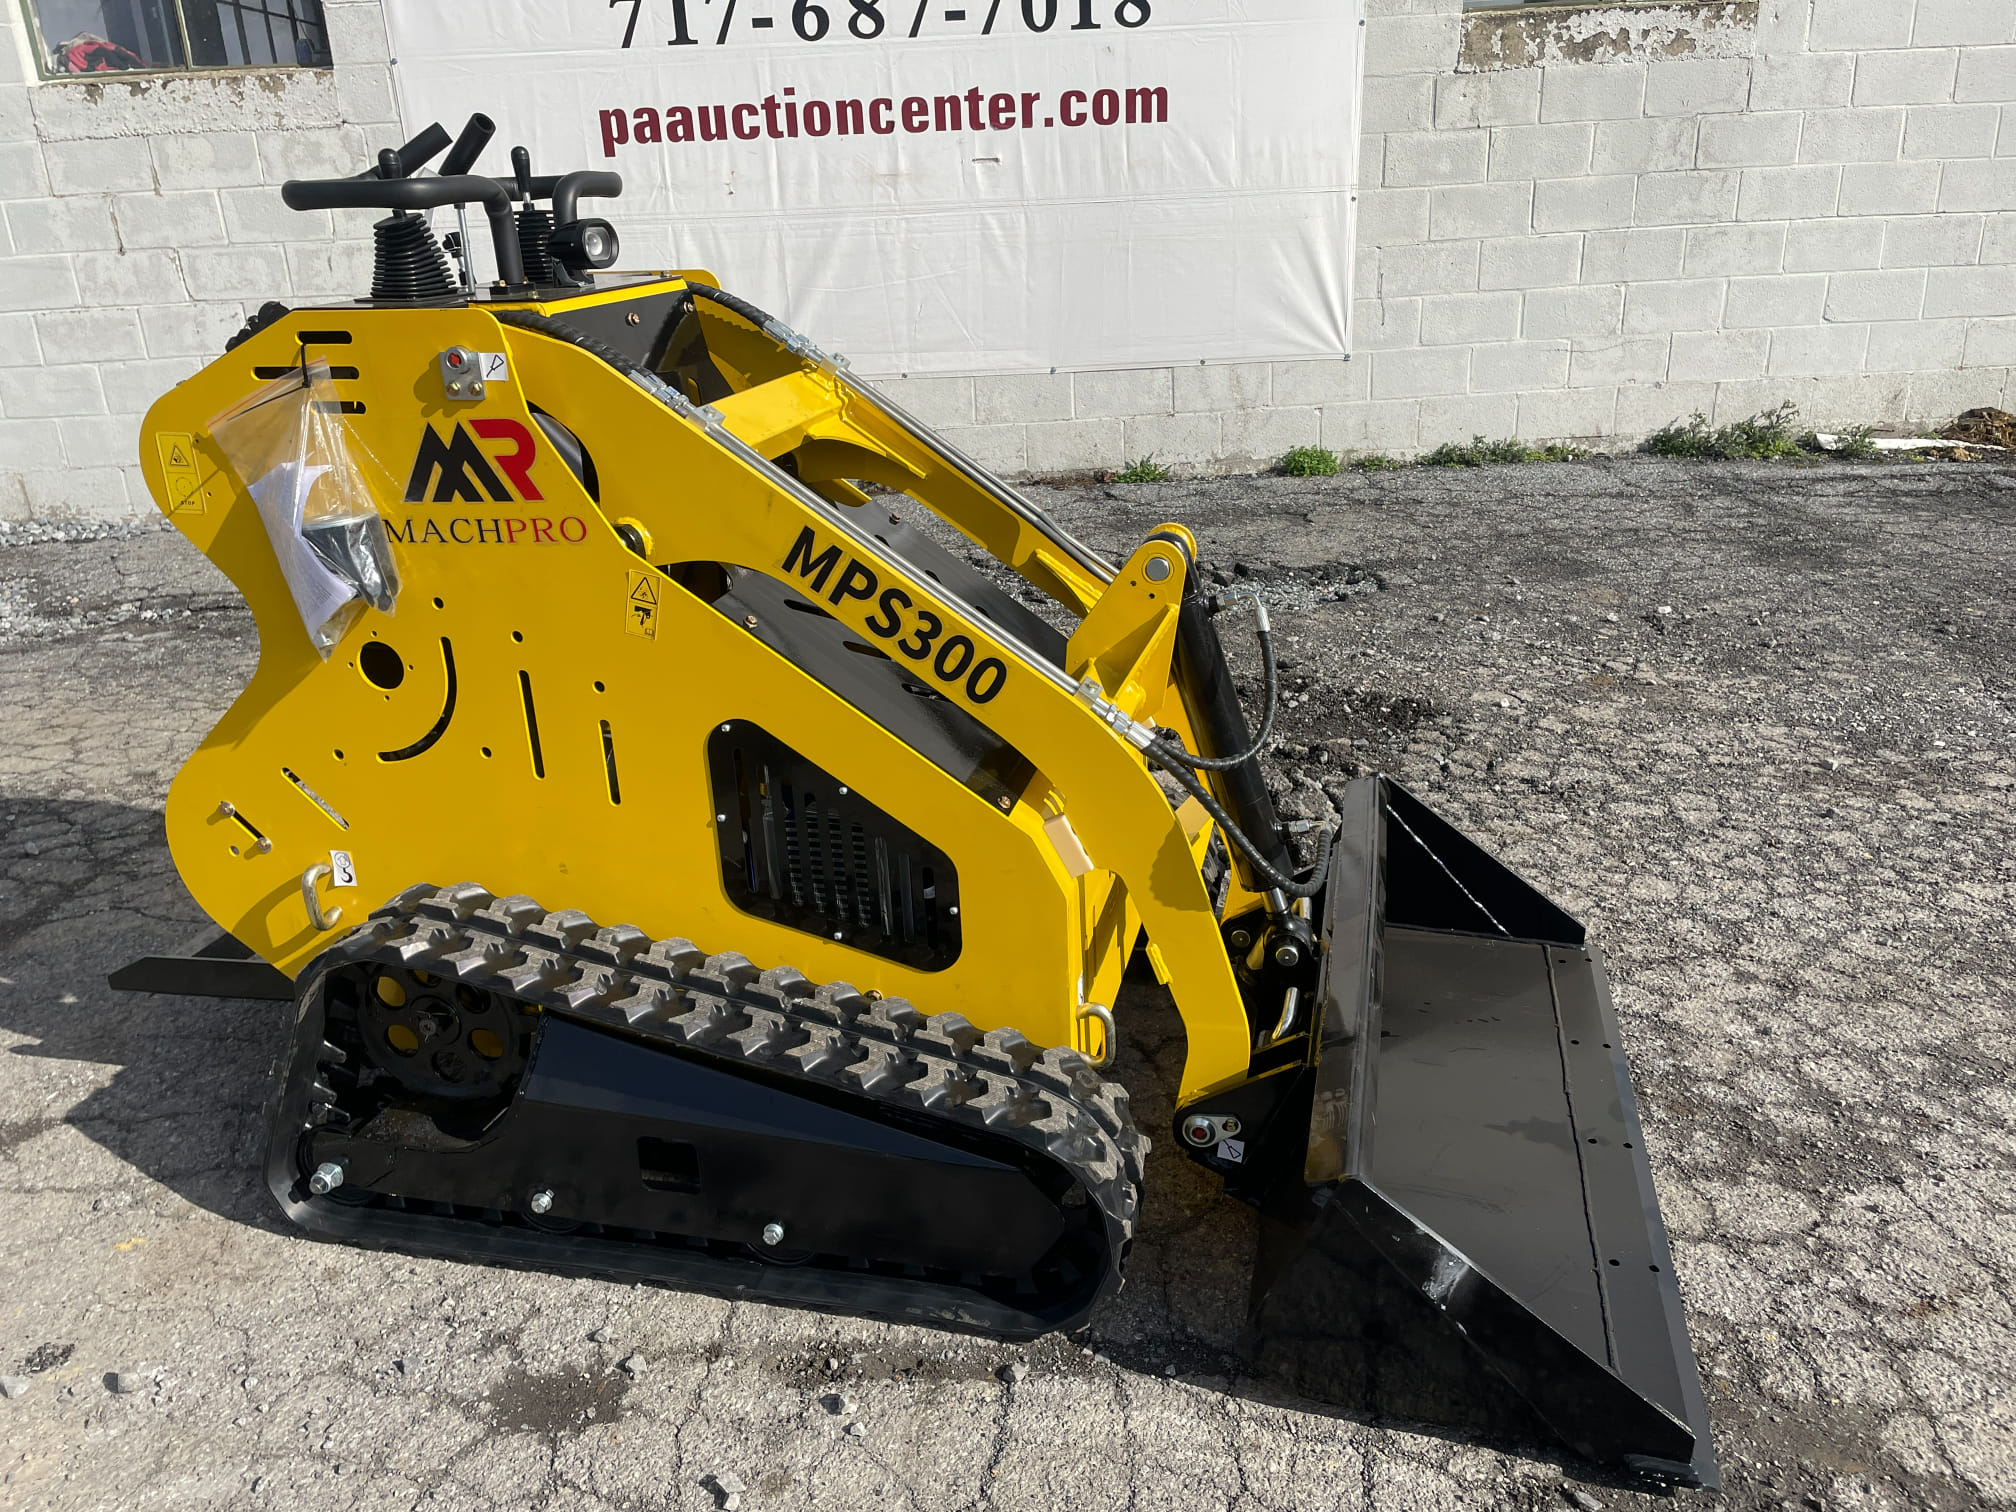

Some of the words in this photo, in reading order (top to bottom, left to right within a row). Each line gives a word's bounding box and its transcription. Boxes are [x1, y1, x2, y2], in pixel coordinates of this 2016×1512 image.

[599, 86, 1168, 157] paauctioncenter.com
[382, 516, 588, 544] MACHPRO
[781, 525, 1007, 704] MPS300
